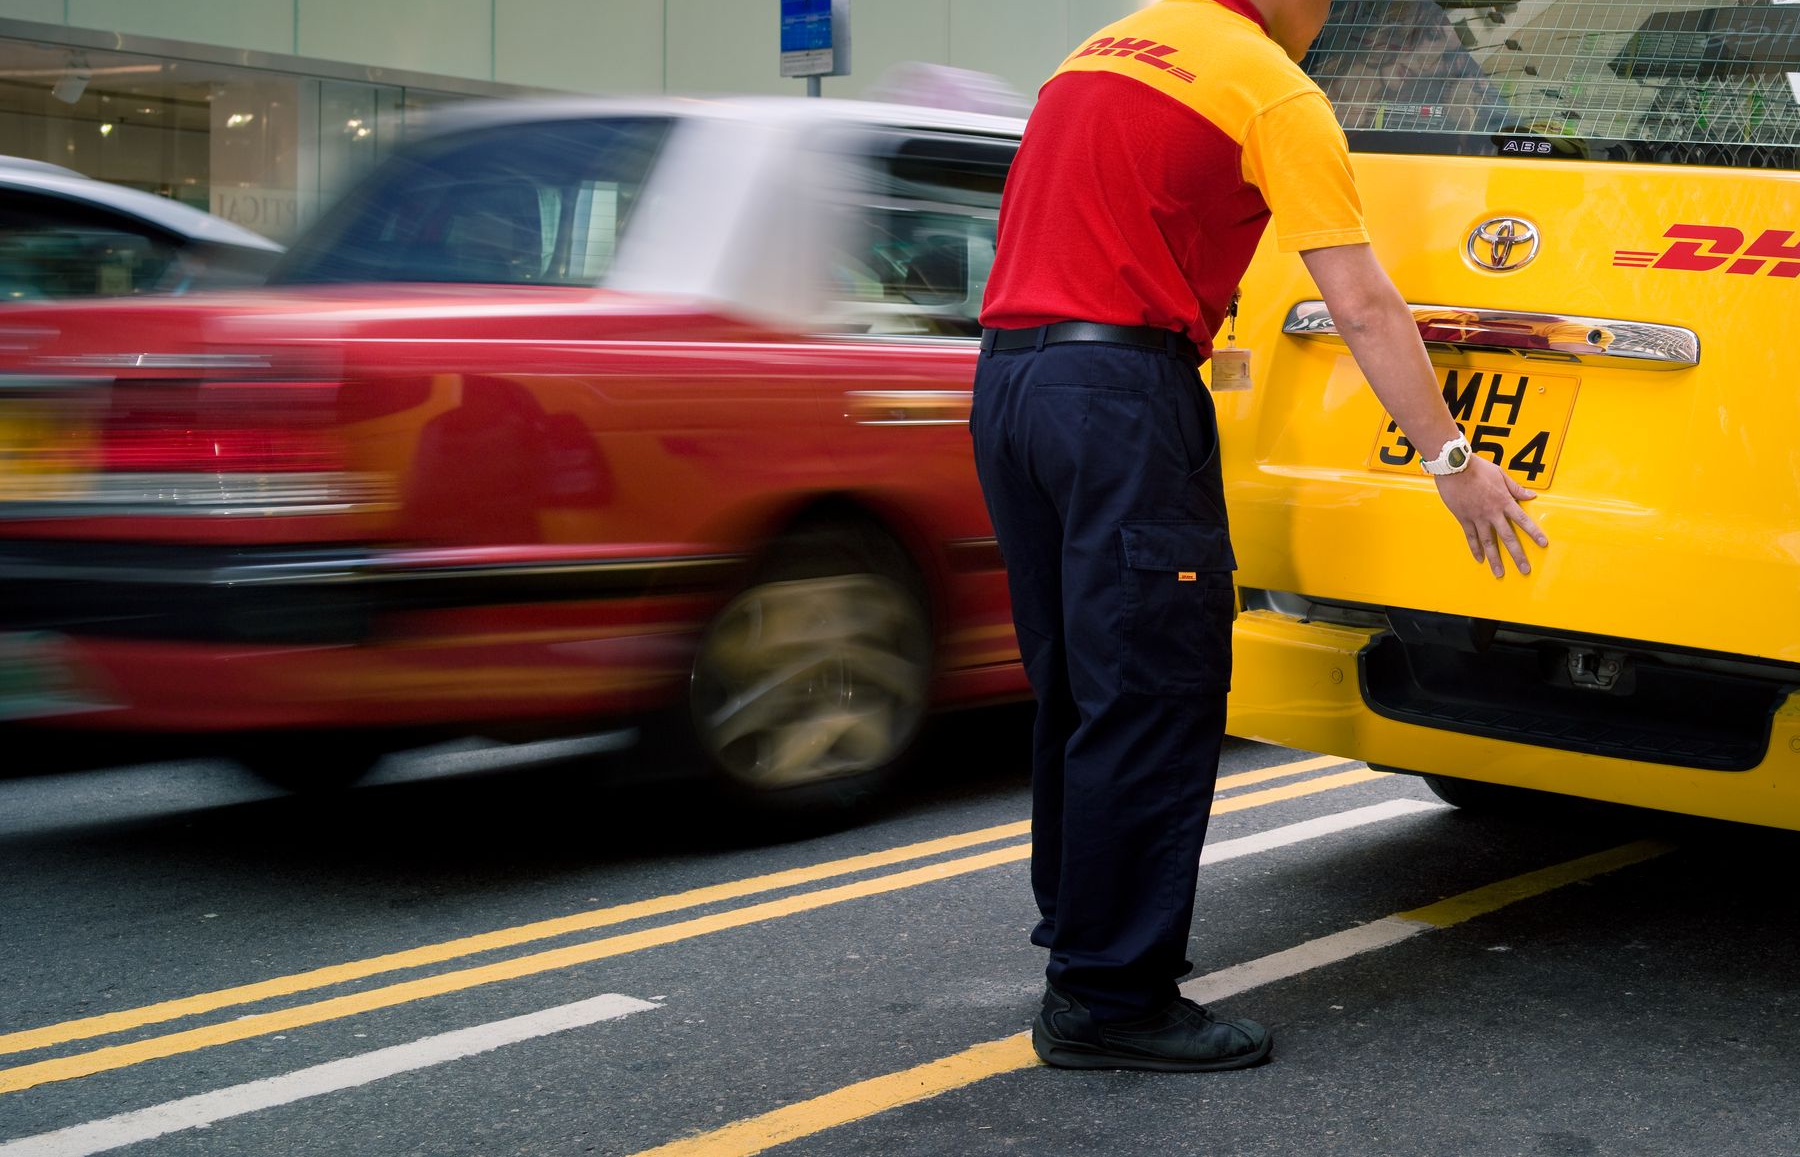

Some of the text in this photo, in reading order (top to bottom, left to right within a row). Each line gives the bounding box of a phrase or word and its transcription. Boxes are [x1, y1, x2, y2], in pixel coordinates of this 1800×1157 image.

[1066, 37, 1179, 70] DHL
[1503, 140, 1552, 154] ABS
[1442, 370, 1530, 425] MH
[1379, 420, 1551, 482] 354
